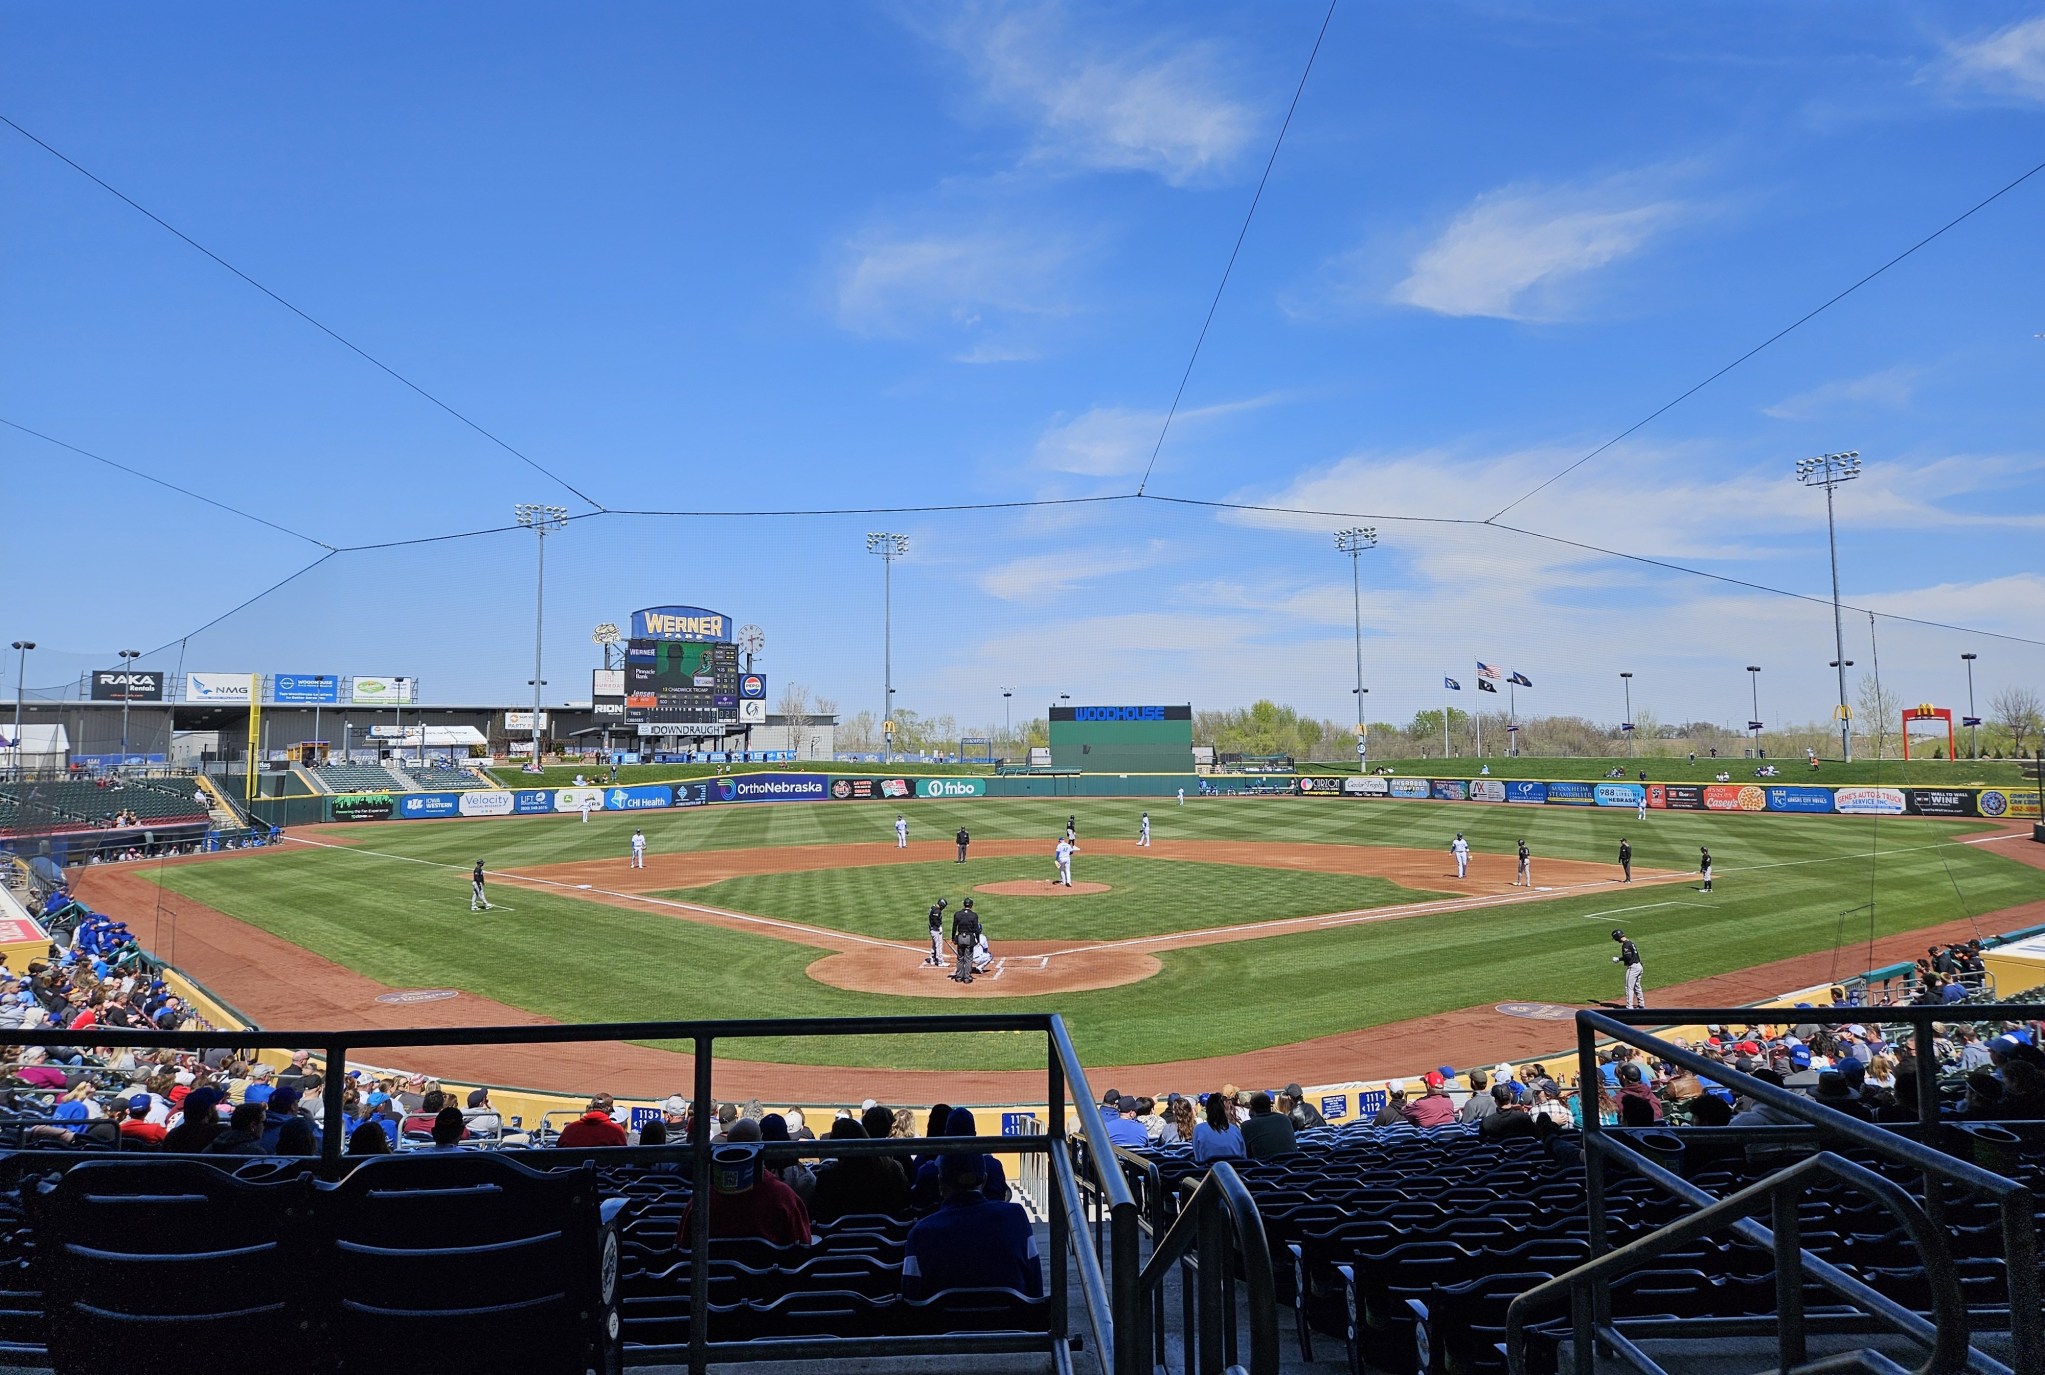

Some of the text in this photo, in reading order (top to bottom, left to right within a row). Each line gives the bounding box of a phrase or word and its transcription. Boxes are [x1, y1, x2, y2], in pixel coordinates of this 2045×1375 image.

[644, 612, 722, 637] WERNER
[100, 674, 155, 685] RAKA
[594, 704, 623, 714] RION
[1075, 706, 1164, 721] WOODHOUSE
[654, 726, 724, 734] DOWNDRAUGHT
[737, 781, 822, 794] OrthoNebraska
[945, 781, 974, 794] fnbo
[1313, 779, 1339, 787] CURZON
[466, 793, 509, 805] Velocity
[627, 797, 665, 807] CHI Health
[1775, 797, 1785, 805] KC
[1838, 793, 1856, 803] GENE'S
[1882, 793, 1902, 803] TRUCK
[1707, 798, 1739, 809] Casey's
[1366, 1093, 1378, 1102] 111
[1367, 1103, 1380, 1112] 112
[639, 1110, 654, 1119] 113
